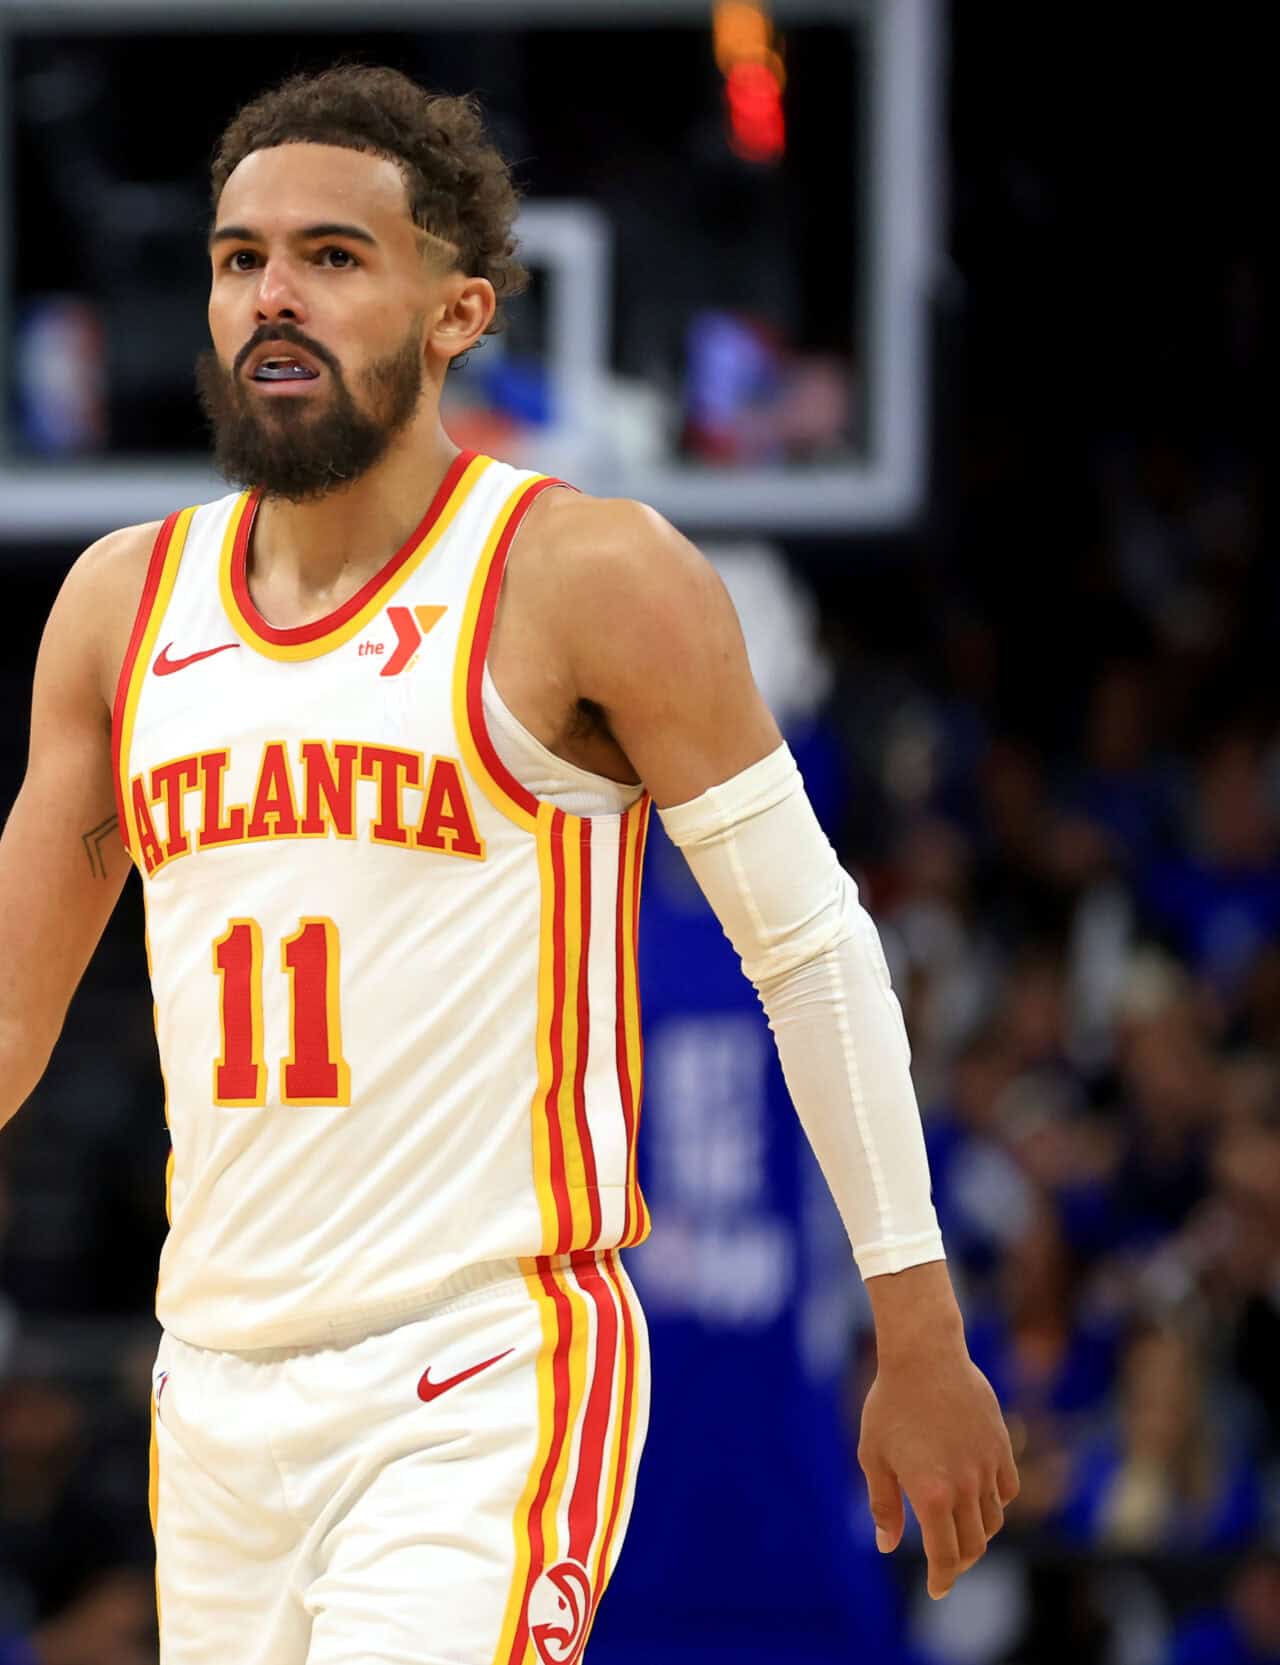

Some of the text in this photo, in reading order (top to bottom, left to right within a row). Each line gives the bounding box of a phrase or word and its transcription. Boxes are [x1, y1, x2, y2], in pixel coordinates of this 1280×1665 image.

[357, 641, 385, 656] the
[131, 739, 486, 880] ATLANTA
[212, 917, 351, 1107] 11
